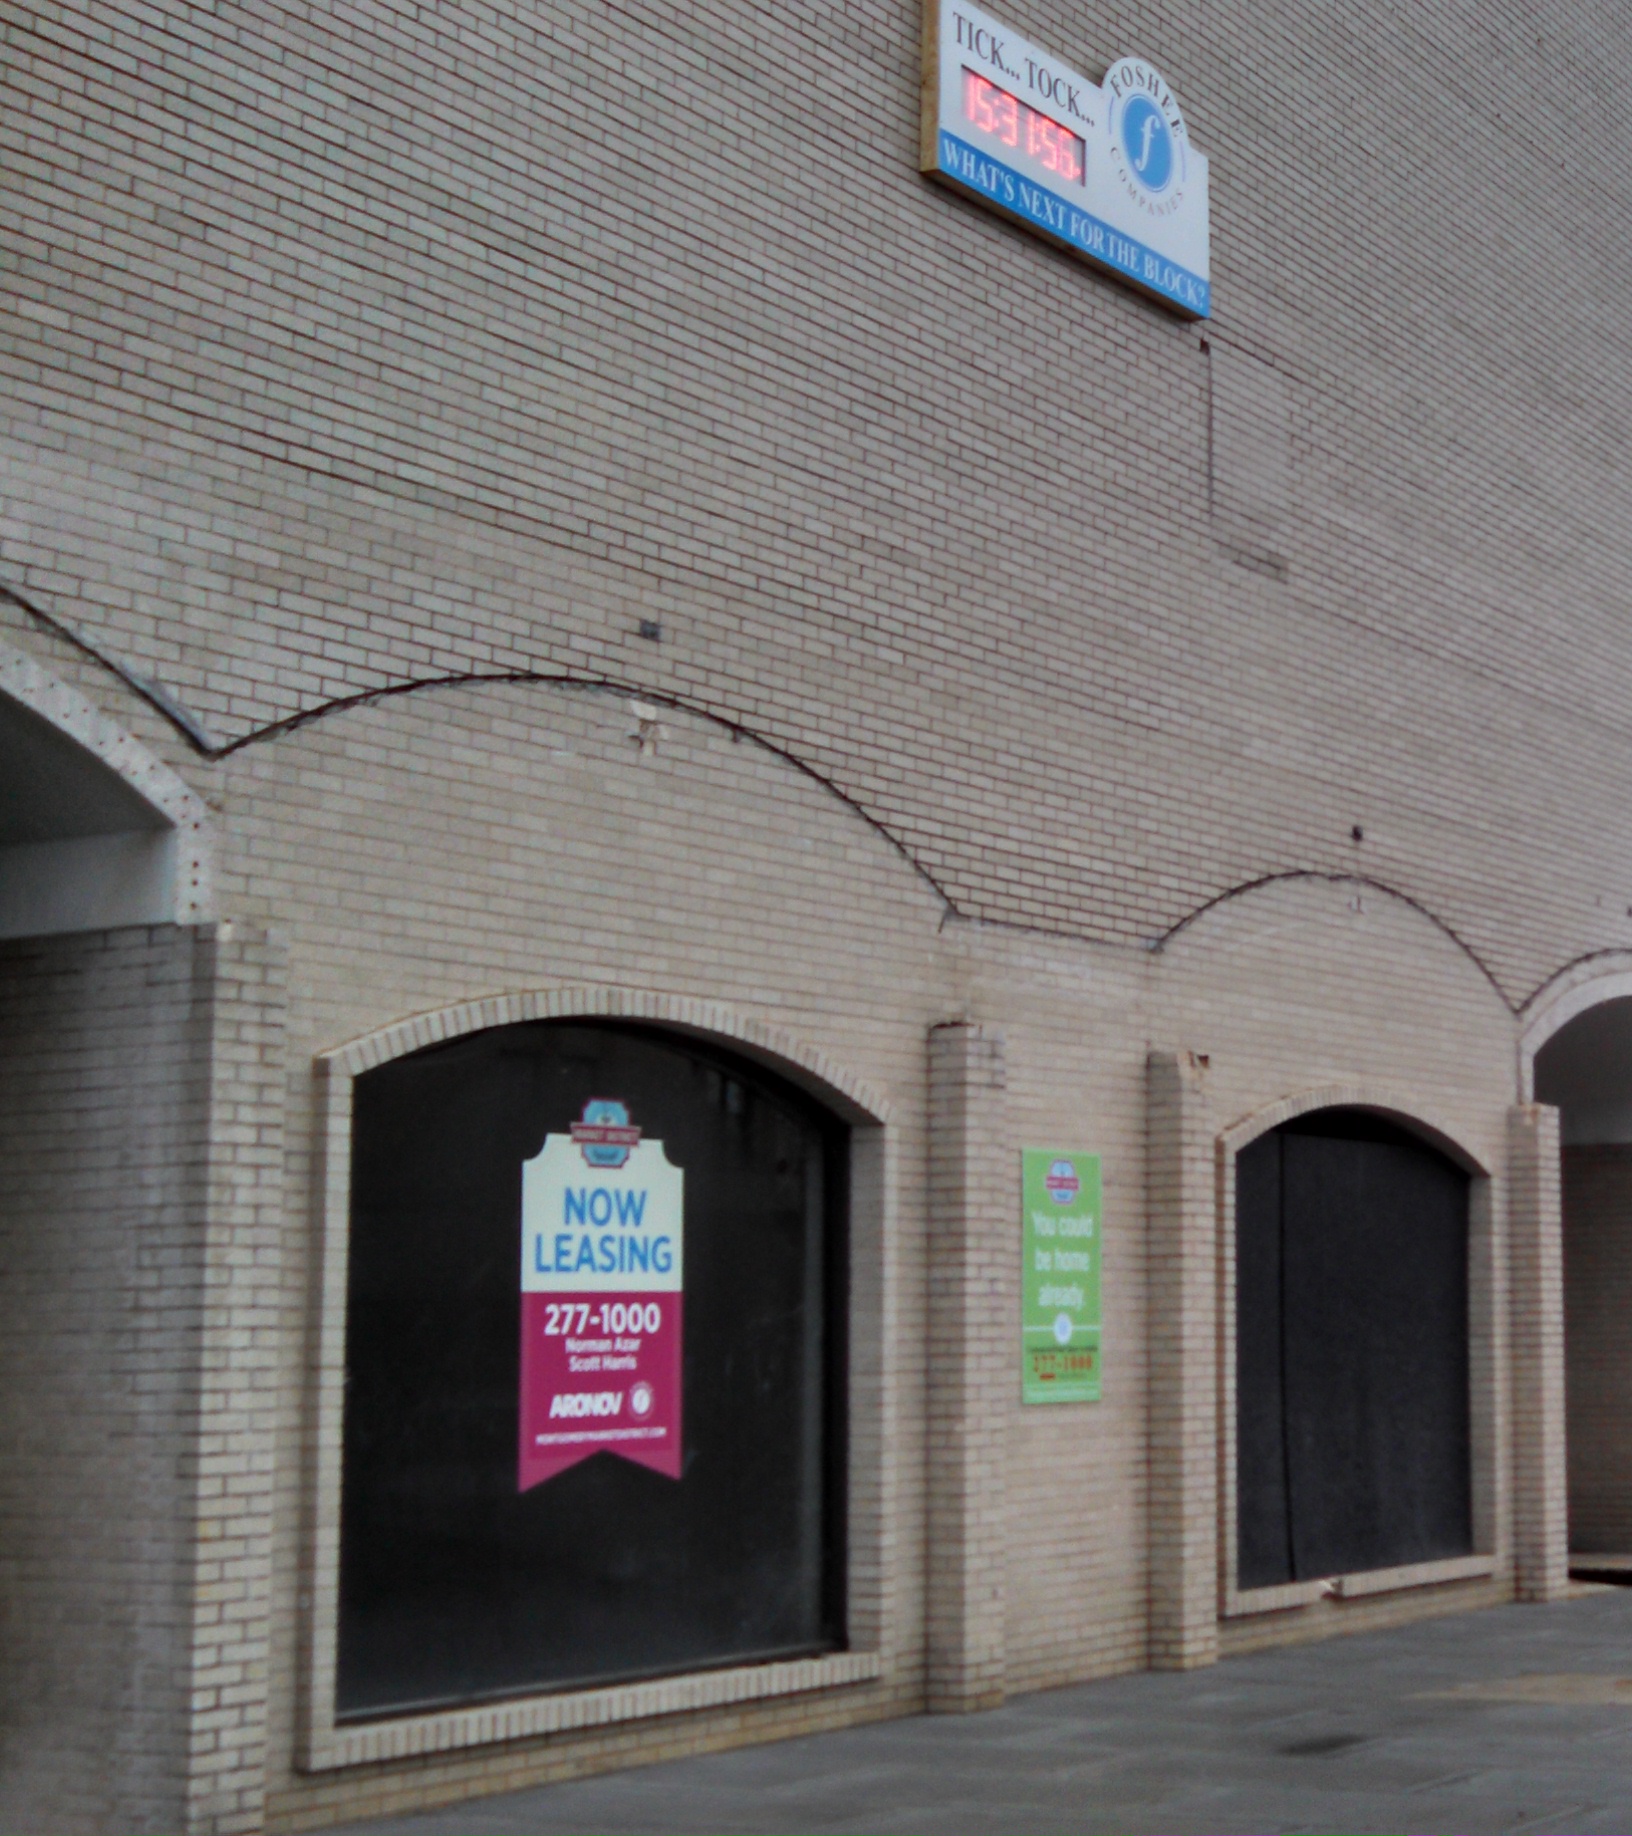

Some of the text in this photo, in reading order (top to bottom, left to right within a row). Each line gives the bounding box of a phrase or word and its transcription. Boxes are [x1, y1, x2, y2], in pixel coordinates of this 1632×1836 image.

[953, 12, 1095, 127] TICK... TOCK...
[1110, 65, 1184, 138] FOSHEE
[942, 139, 1206, 309] WHAT'S NEXT FOR THE BLOCK?
[563, 1187, 647, 1227] NOW
[535, 1233, 672, 1274] LEASING
[544, 1303, 662, 1336] 277-1000
[549, 1391, 623, 1419] ARONOV
